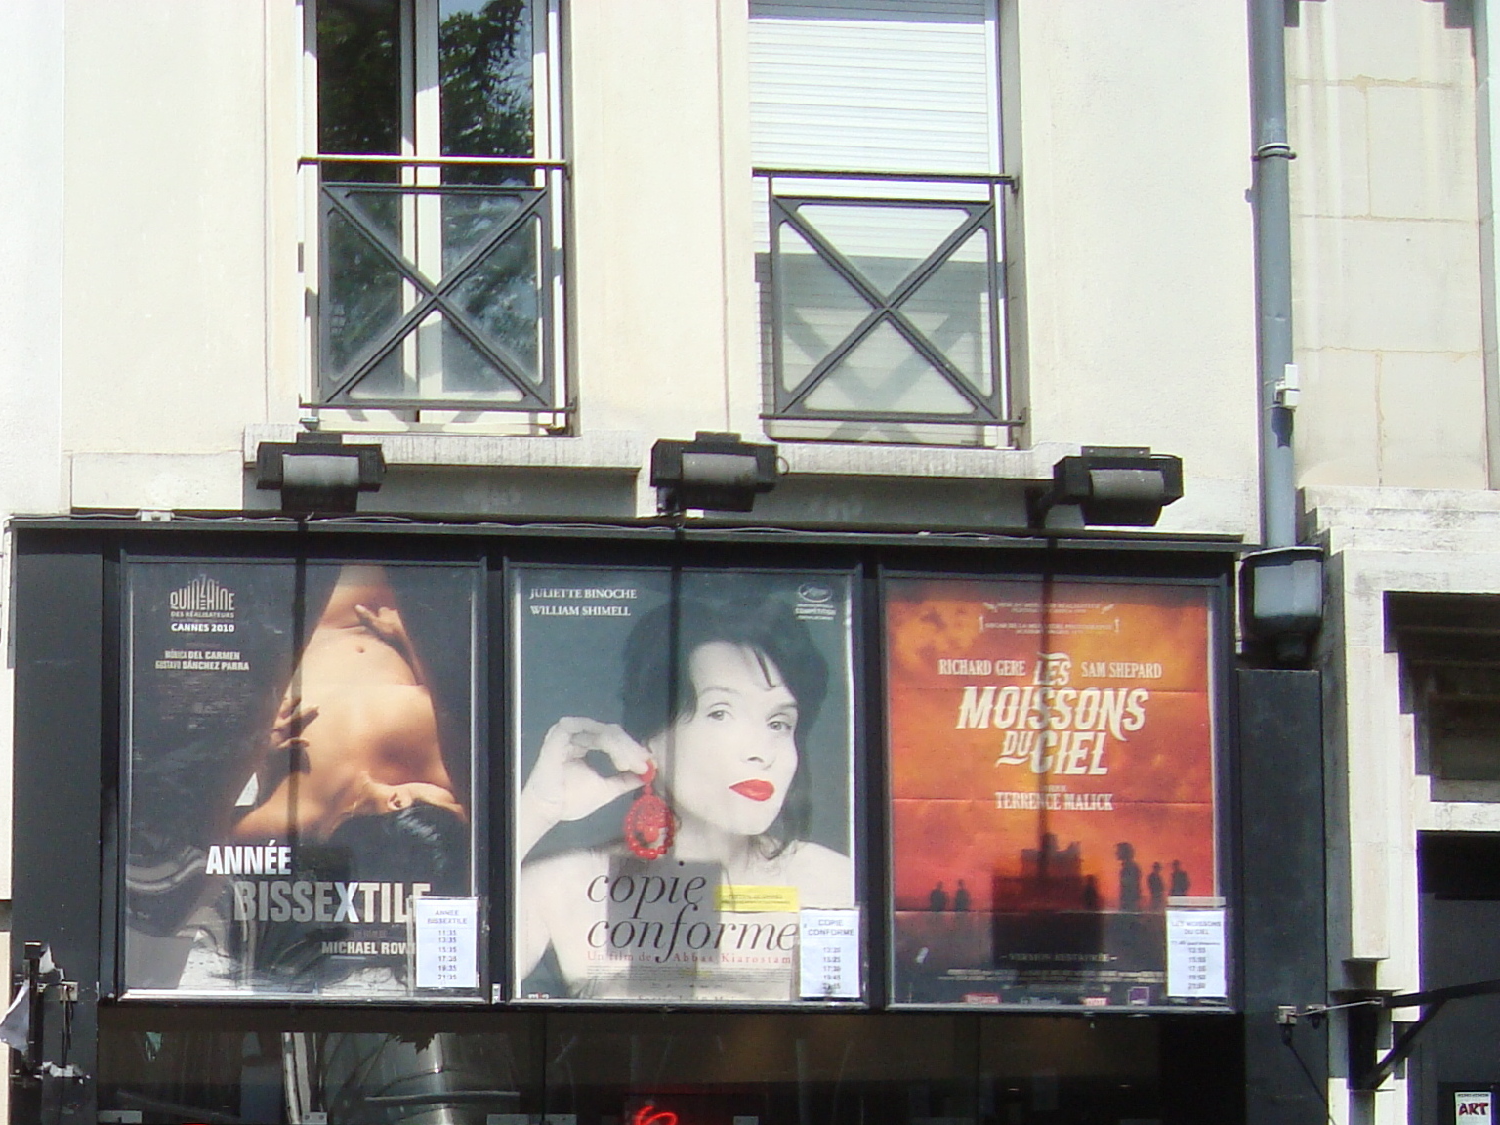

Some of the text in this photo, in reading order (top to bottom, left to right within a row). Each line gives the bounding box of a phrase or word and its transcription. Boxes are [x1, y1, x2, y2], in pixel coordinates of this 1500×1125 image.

[170, 574, 235, 610] QUINZAINE
[530, 588, 637, 599] JULIETTE BINOCHE
[530, 605, 631, 616] WILLIAM SHIMELL
[171, 623, 234, 632] CANNES 2010
[188, 651, 203, 659] DEL
[205, 651, 240, 660] CARMEN
[183, 660, 220, 670] SÁNCHEZ
[221, 661, 250, 671] PARRA
[938, 660, 1026, 676] RICHARD GERE
[1033, 651, 1072, 686] LES
[1081, 661, 1163, 679] SAM SHEPARD
[955, 686, 1149, 741] MOISSONS
[996, 730, 1109, 775] DU CIEL
[994, 792, 1113, 811] TERRENCE MALICK
[205, 839, 292, 875] ANNÉE
[587, 861, 707, 919] copie
[587, 902, 799, 963] conforme
[321, 941, 378, 955] MICHAEL
[588, 953, 791, 963] Un film de Abbas Kiarostam
[1458, 1103, 1488, 1116] ART
